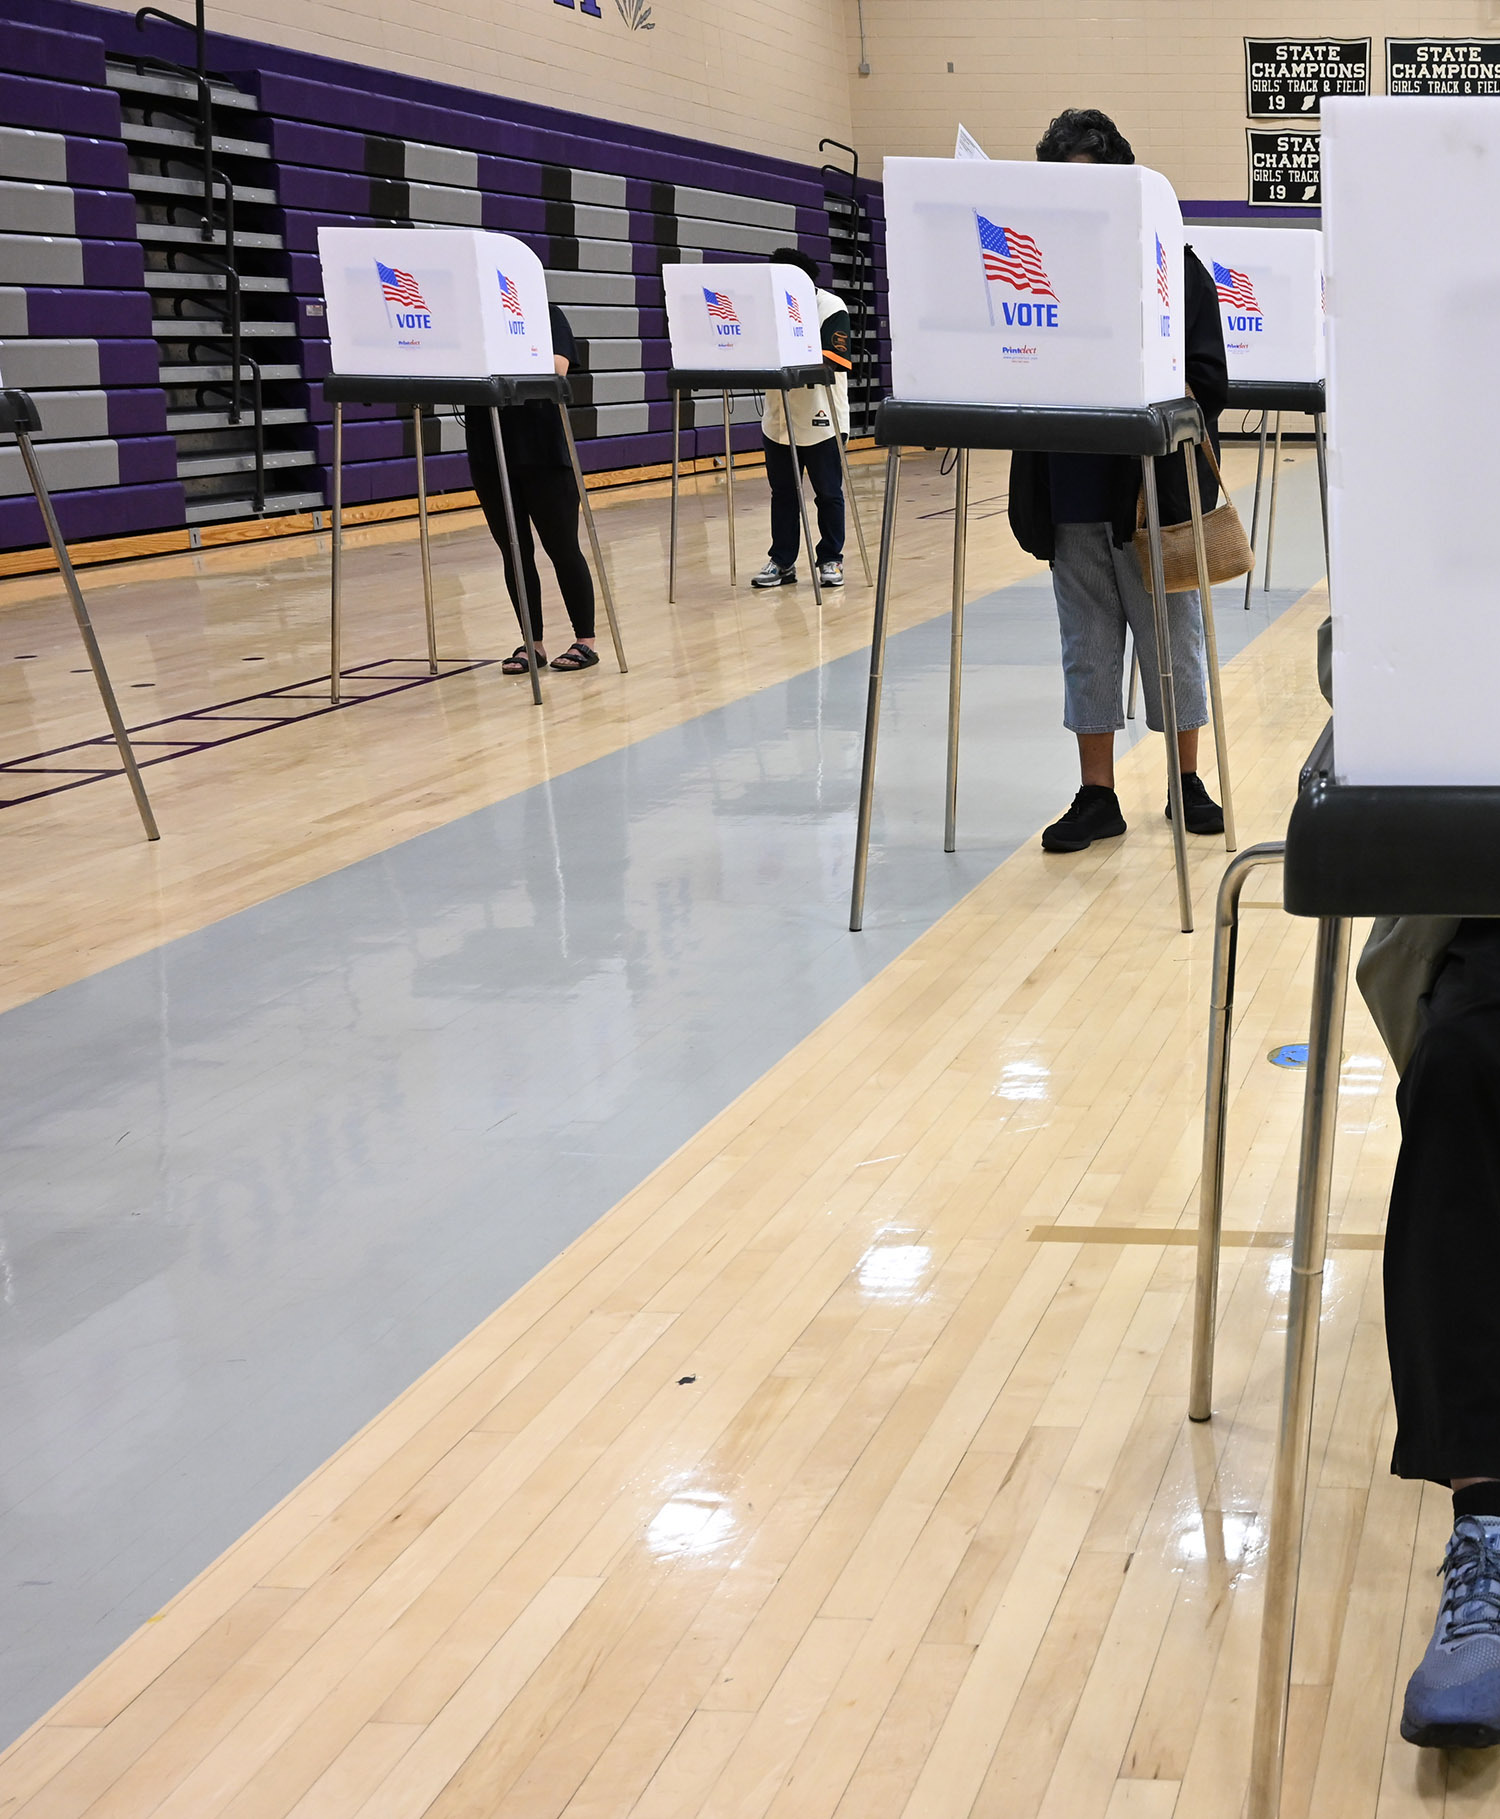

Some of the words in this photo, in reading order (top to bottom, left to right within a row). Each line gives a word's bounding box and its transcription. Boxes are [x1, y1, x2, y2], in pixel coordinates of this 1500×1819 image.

[1276, 46, 1340, 61] STATE
[1416, 47, 1481, 62] STATE
[1252, 63, 1365, 79] CHAMPIONS
[1252, 80, 1285, 93] GIRLS'
[1288, 80, 1321, 93] TRACK
[1324, 80, 1332, 93] &
[1336, 80, 1365, 93] FIELD
[1392, 80, 1422, 94] GIRLS'
[1428, 80, 1462, 93] TRACK
[1465, 80, 1472, 93] &
[1268, 95, 1285, 110] 19
[1254, 154, 1320, 169] CHAMP
[1254, 170, 1283, 183] GIRLS'
[1289, 170, 1320, 183] TRACK
[1269, 185, 1286, 200] 19
[396, 314, 432, 329] VOTE
[1002, 302, 1059, 327] VOTE
[717, 325, 741, 335] VOTE
[1228, 316, 1263, 331] VOTE
